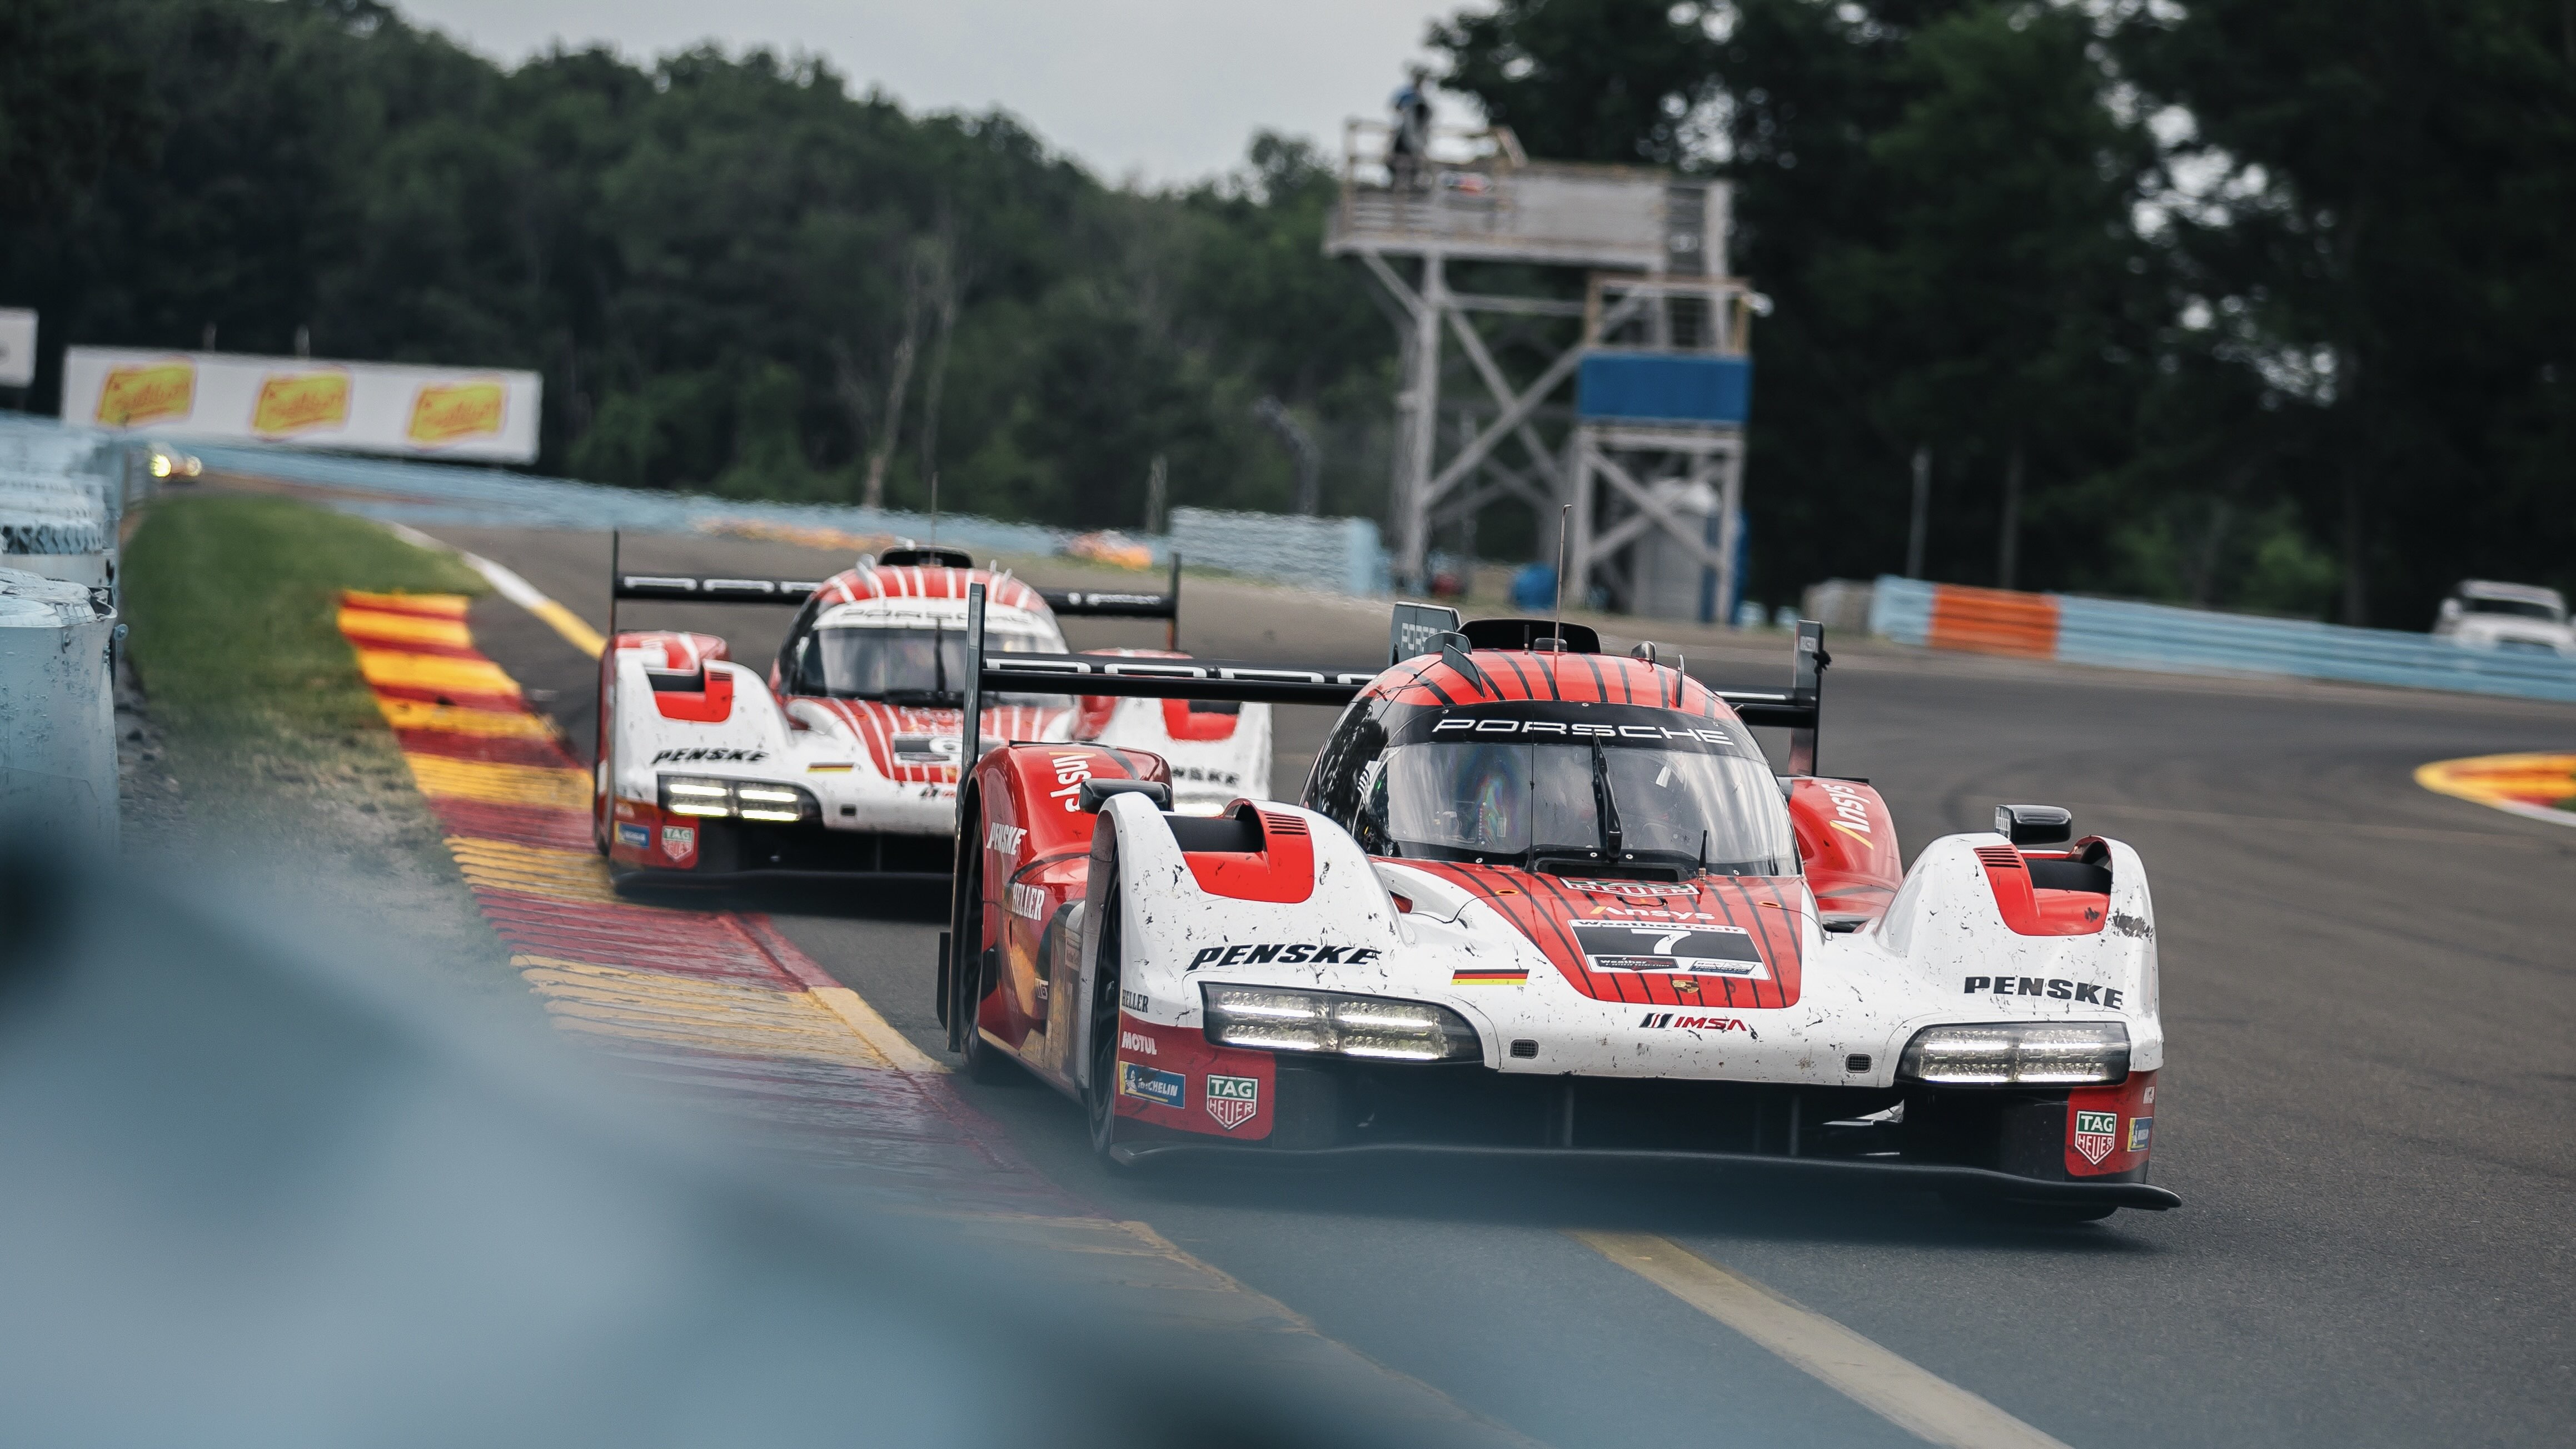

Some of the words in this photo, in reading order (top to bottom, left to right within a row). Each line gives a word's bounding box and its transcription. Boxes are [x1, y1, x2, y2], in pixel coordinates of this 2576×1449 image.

[1401, 623, 1450, 652] PORS
[1432, 719, 1735, 745] PORSCHE
[650, 748, 770, 766] PENSKE
[1048, 751, 1097, 813] Ansys
[1821, 783, 1874, 849] Ansys
[665, 827, 690, 838] TAG
[986, 821, 1028, 855] PENSKE
[1012, 882, 1045, 921] HELLER
[1590, 906, 1716, 920] Ansys
[1577, 920, 1740, 932] WeatherTech
[1630, 928, 1692, 955] 7
[1185, 944, 1383, 972] PENSKE
[1122, 989, 1149, 1013] HELLER
[1964, 976, 2124, 1010] PENSKE
[1673, 1016, 1747, 1032] IMSA
[1121, 1030, 1157, 1055] MOTUL
[1211, 1079, 1253, 1098] TAG
[1209, 1098, 1253, 1125] HEUER
[2080, 1114, 2114, 1132] TAG
[2077, 1134, 2113, 1160] HEUER
